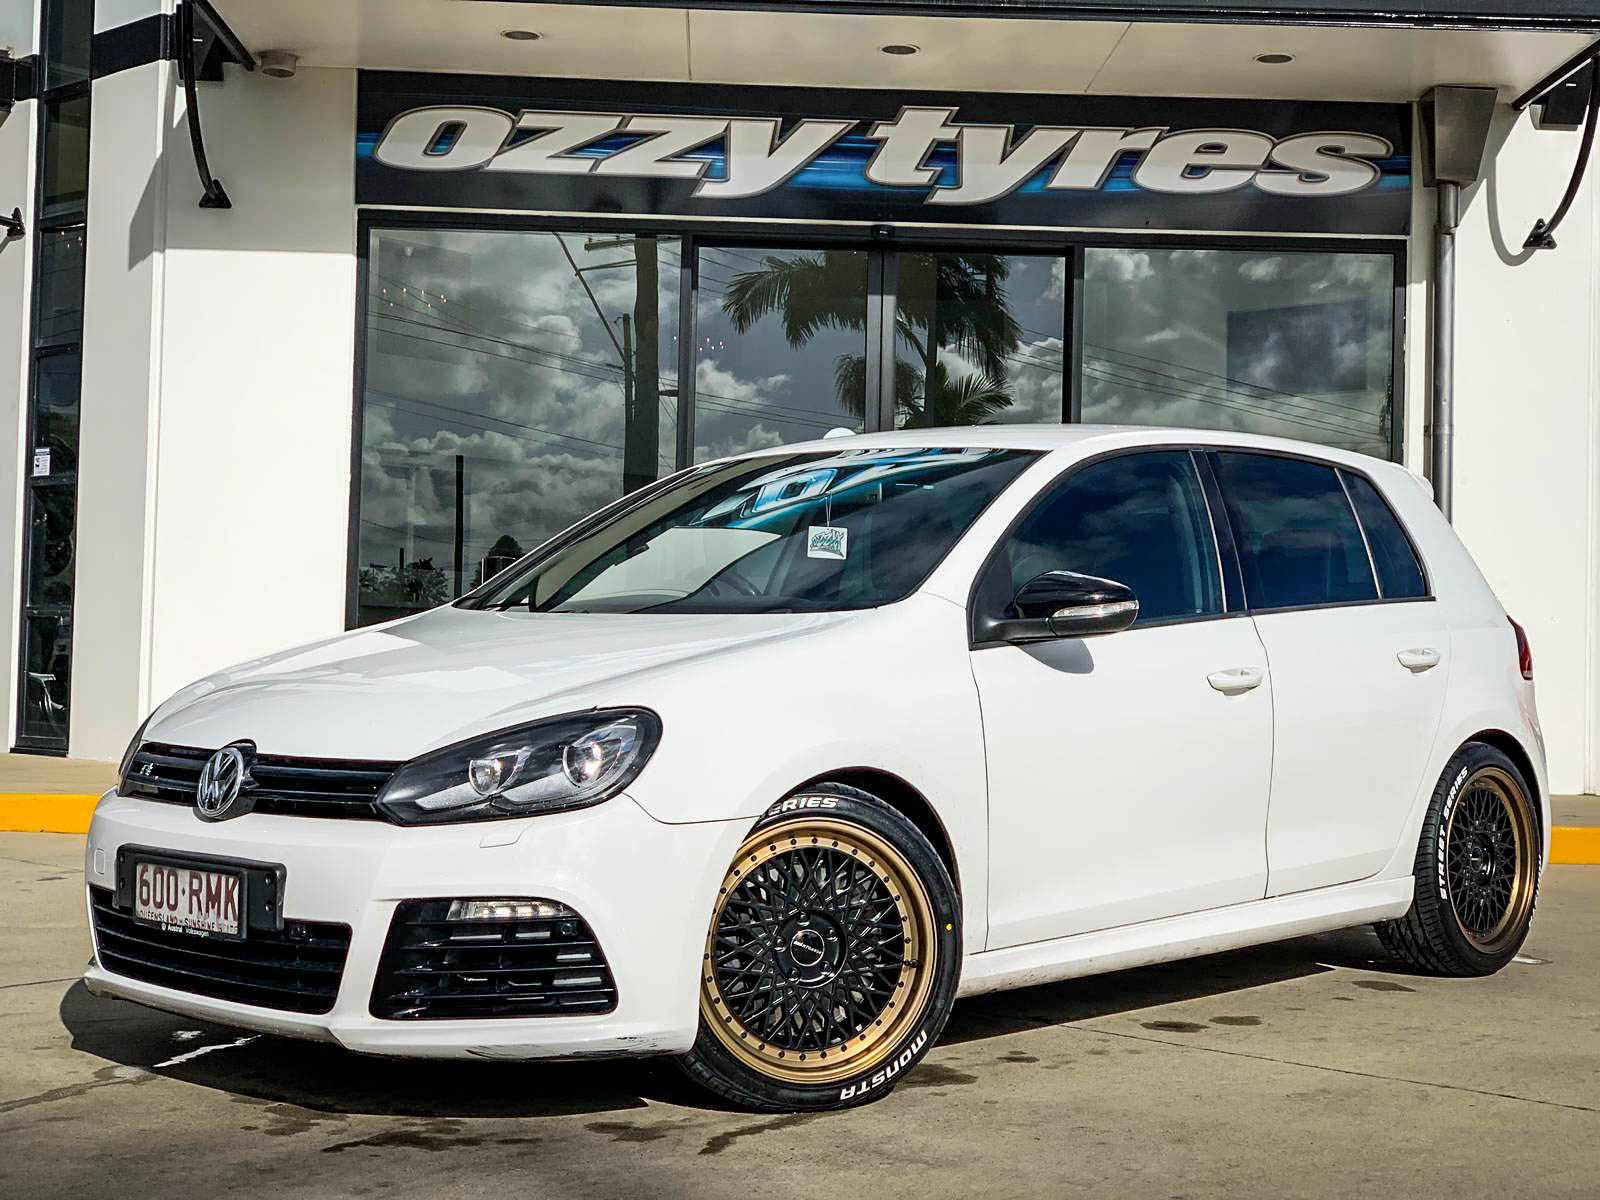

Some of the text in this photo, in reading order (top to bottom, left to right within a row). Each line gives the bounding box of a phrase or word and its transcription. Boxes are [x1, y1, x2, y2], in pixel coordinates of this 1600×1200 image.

[372, 104, 1394, 206] ozzy tyres
[767, 796, 840, 817] ERIES
[1443, 765, 1469, 820] SERIES
